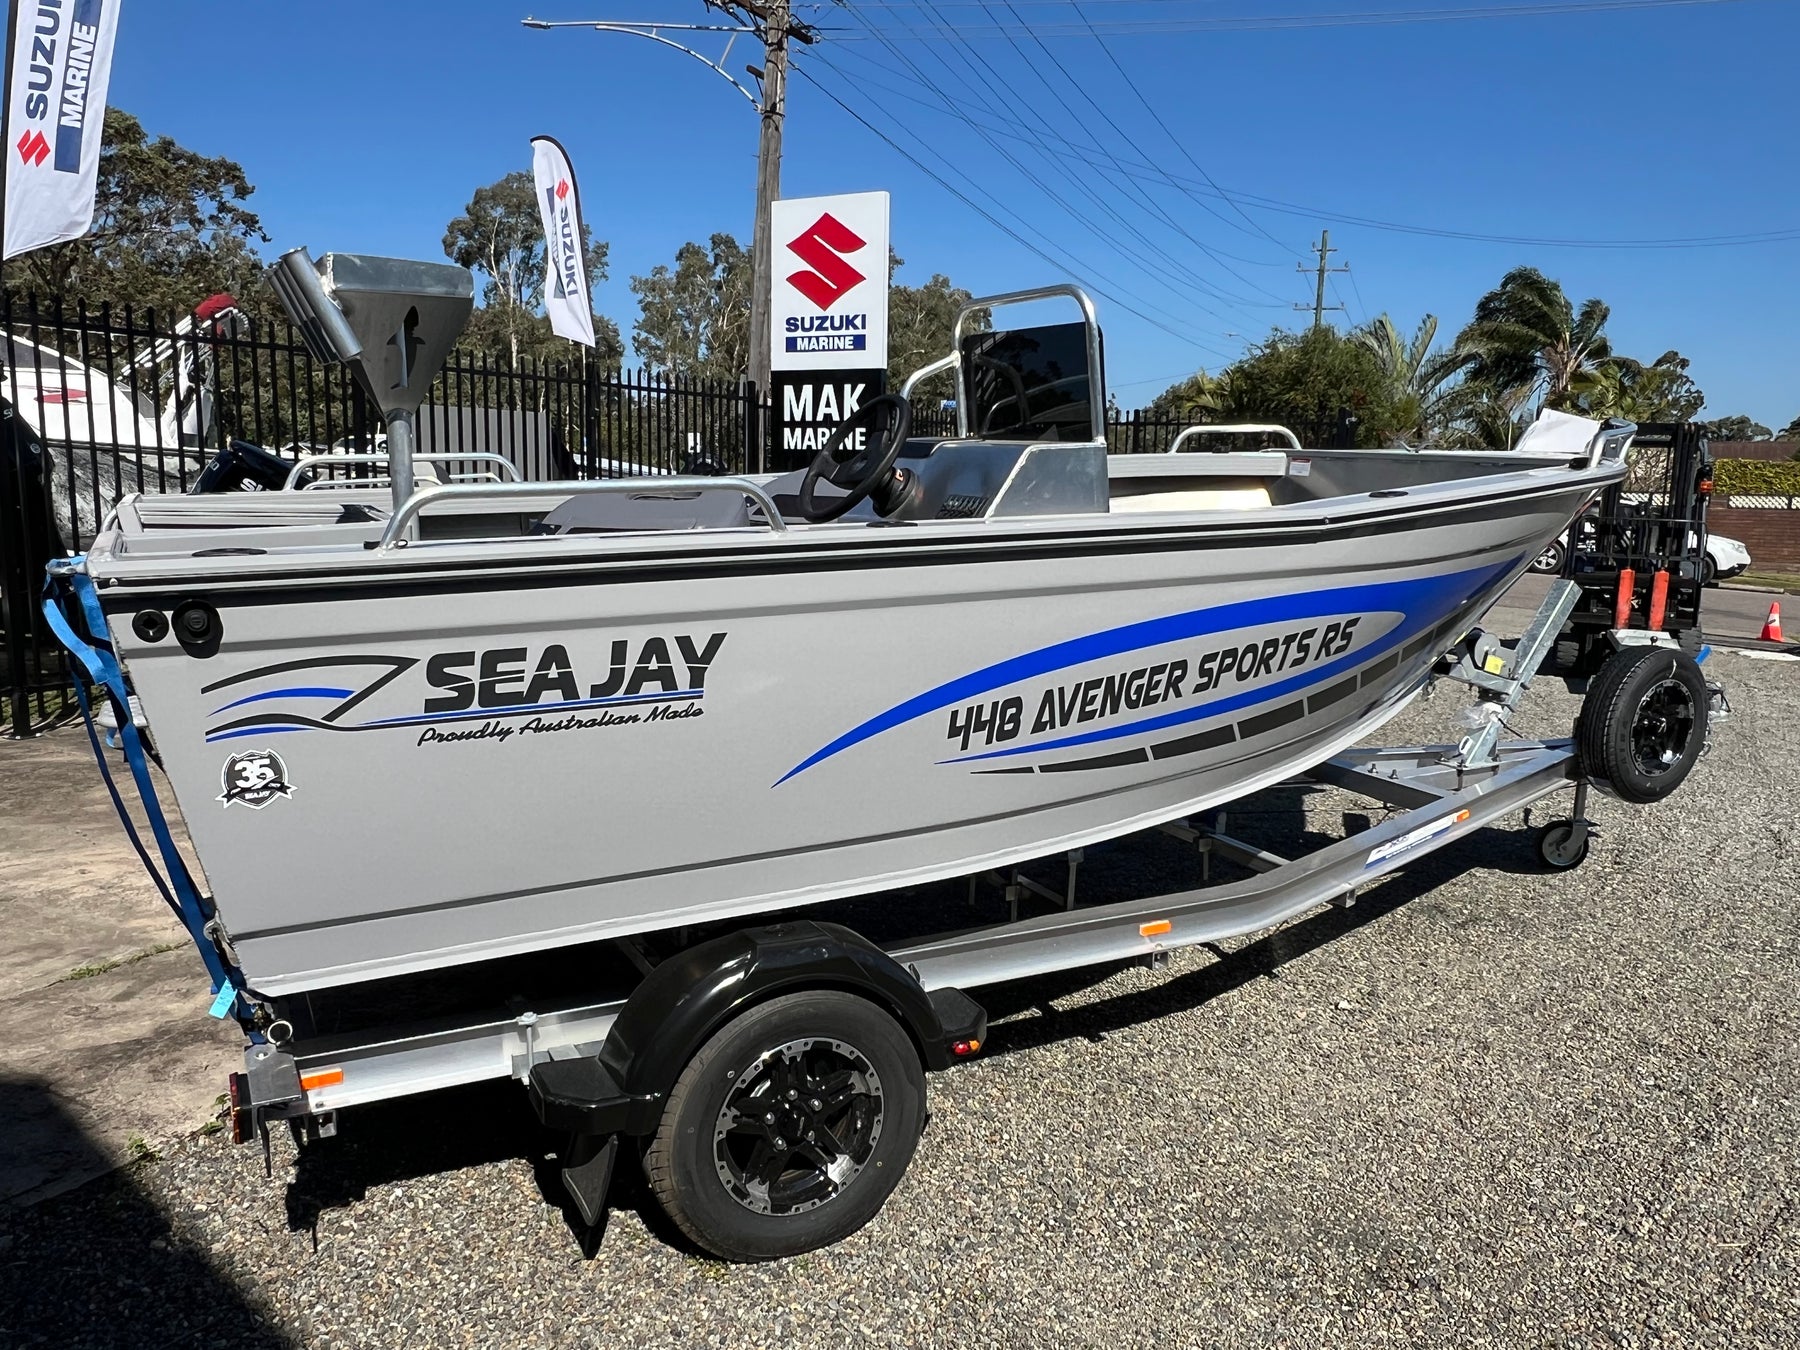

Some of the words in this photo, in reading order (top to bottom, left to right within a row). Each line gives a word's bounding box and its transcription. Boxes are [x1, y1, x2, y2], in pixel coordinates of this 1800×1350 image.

[60, 21, 96, 128] MARINE
[560, 206, 579, 296] SUZUKI
[785, 314, 867, 333] SUZUKI
[796, 336, 854, 351] MARINE
[783, 384, 866, 422] MAK
[783, 428, 866, 450] MARNE
[424, 644, 581, 714] SEA
[590, 632, 728, 699] JAY
[947, 696, 1024, 751] 448
[1031, 659, 1188, 735] AVENGER
[1192, 628, 1318, 694] SPORTS
[1314, 617, 1361, 661] RS
[417, 721, 514, 747] Proudly
[519, 711, 641, 736] Australian
[643, 702, 704, 723] Made
[234, 758, 275, 789] 35
